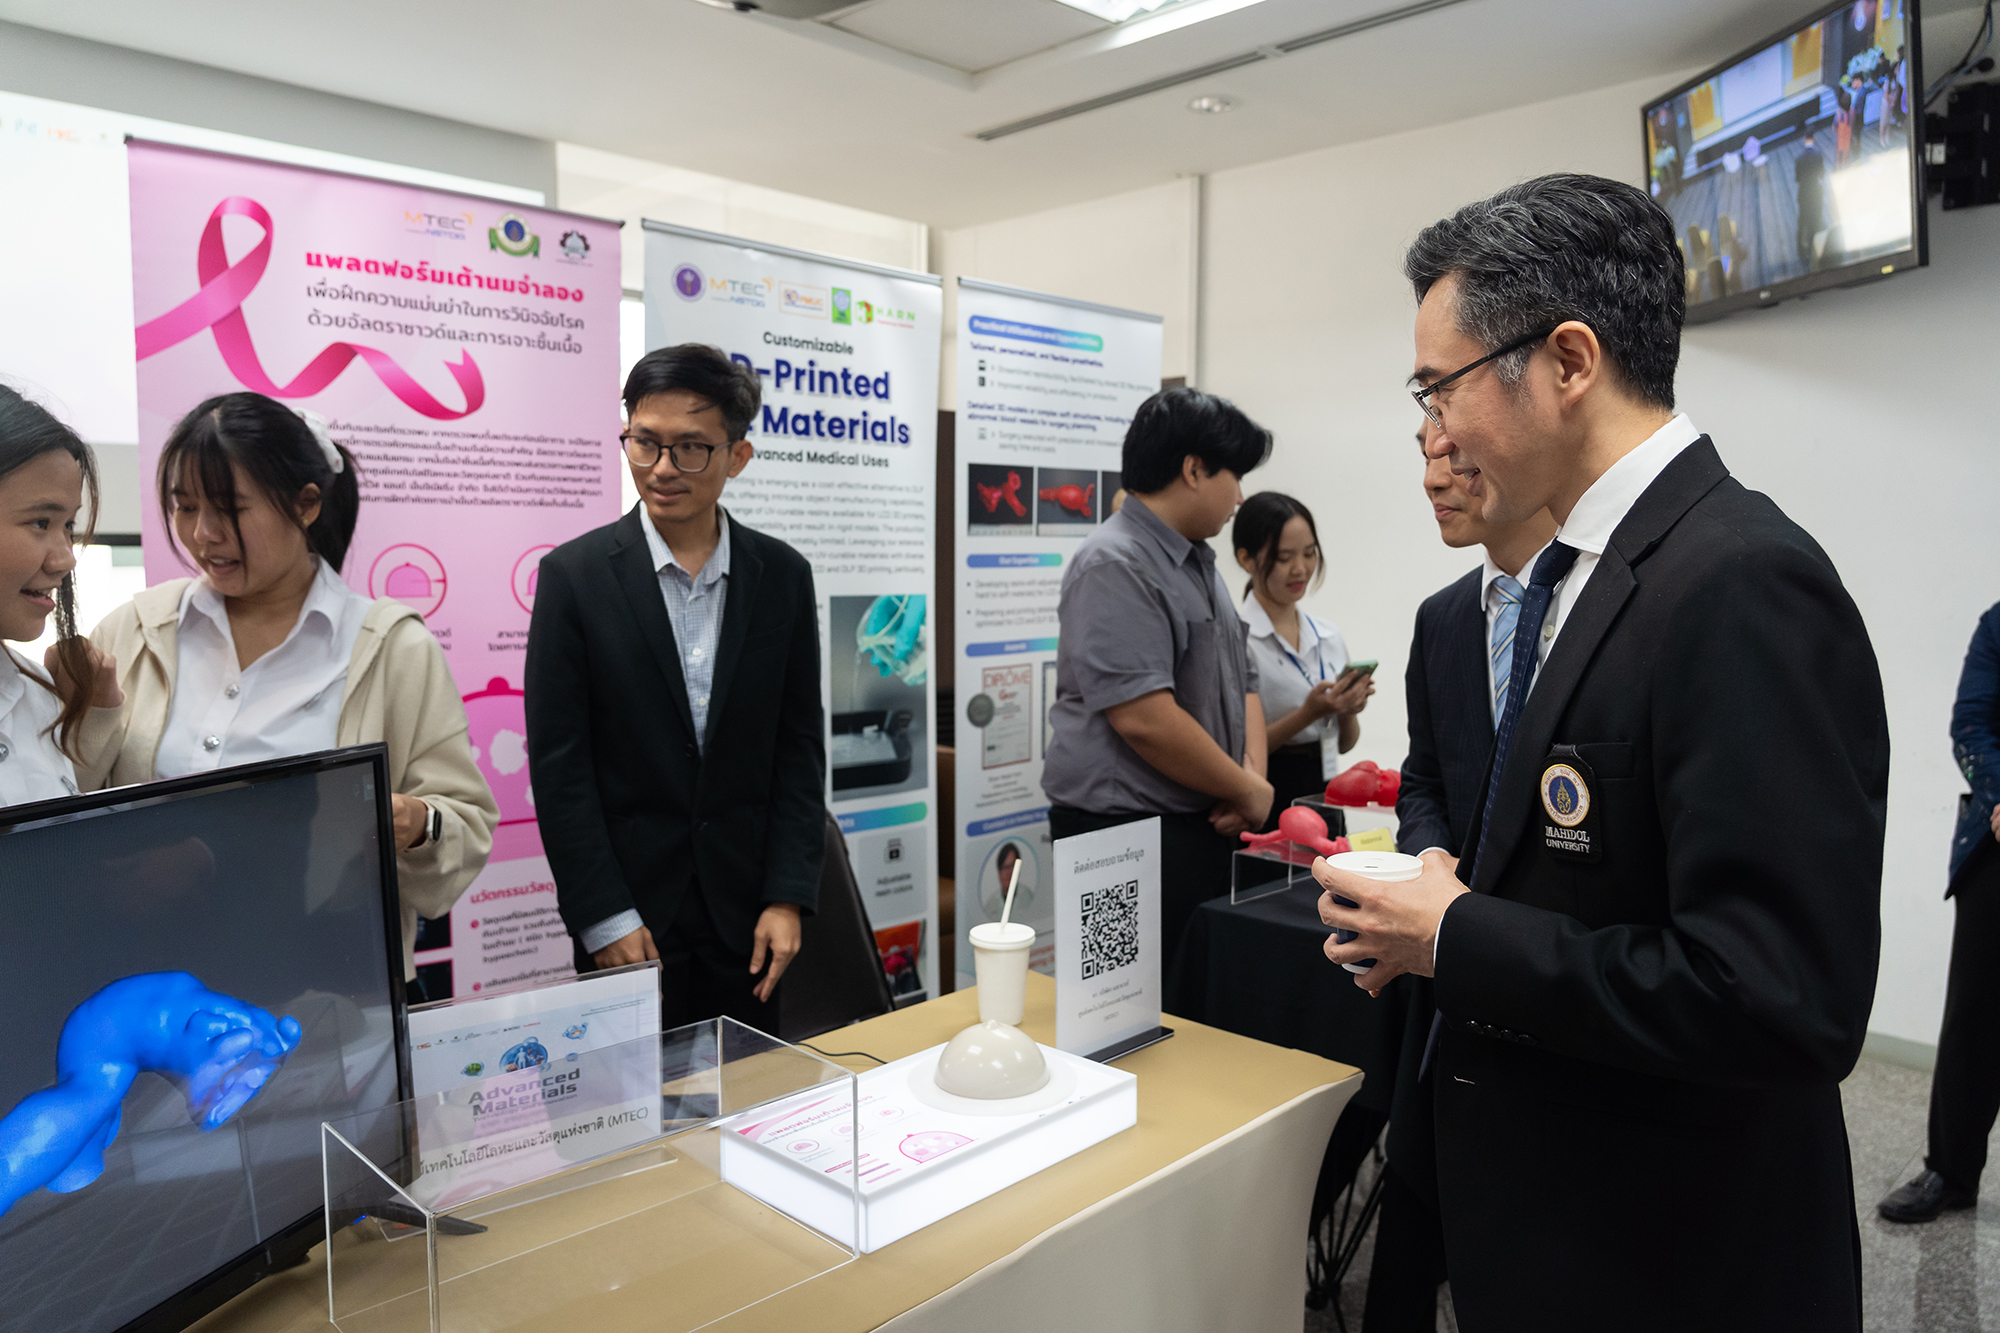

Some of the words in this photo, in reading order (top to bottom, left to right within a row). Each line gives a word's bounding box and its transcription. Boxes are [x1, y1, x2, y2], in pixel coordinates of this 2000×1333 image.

[404, 210, 466, 231] MTEC
[305, 251, 585, 302] แพลตฟอร์มเต้านมจำลอง
[709, 277, 765, 298] MTEC
[306, 277, 585, 330] เพื่อฝึกความแม่นยำในการวินิจฉัยโรค
[307, 307, 583, 355] ด้วยอัลตราซาวด์และการเจาะชิ้นเนื้อ
[762, 331, 855, 355] Customizable
[762, 404, 911, 444] Materials
[751, 449, 804, 463] vanced
[806, 451, 860, 467] Medical
[861, 454, 890, 468] Uses
[1545, 826, 1590, 843] MAHIDOL
[1546, 839, 1590, 853] UNIVERSITY
[1074, 847, 1145, 875] ติดต่อสอบถามข้อมูล
[468, 1068, 580, 1105] Advanced
[472, 1083, 578, 1117] Materials
[607, 1105, 650, 1129] (MTEC)
